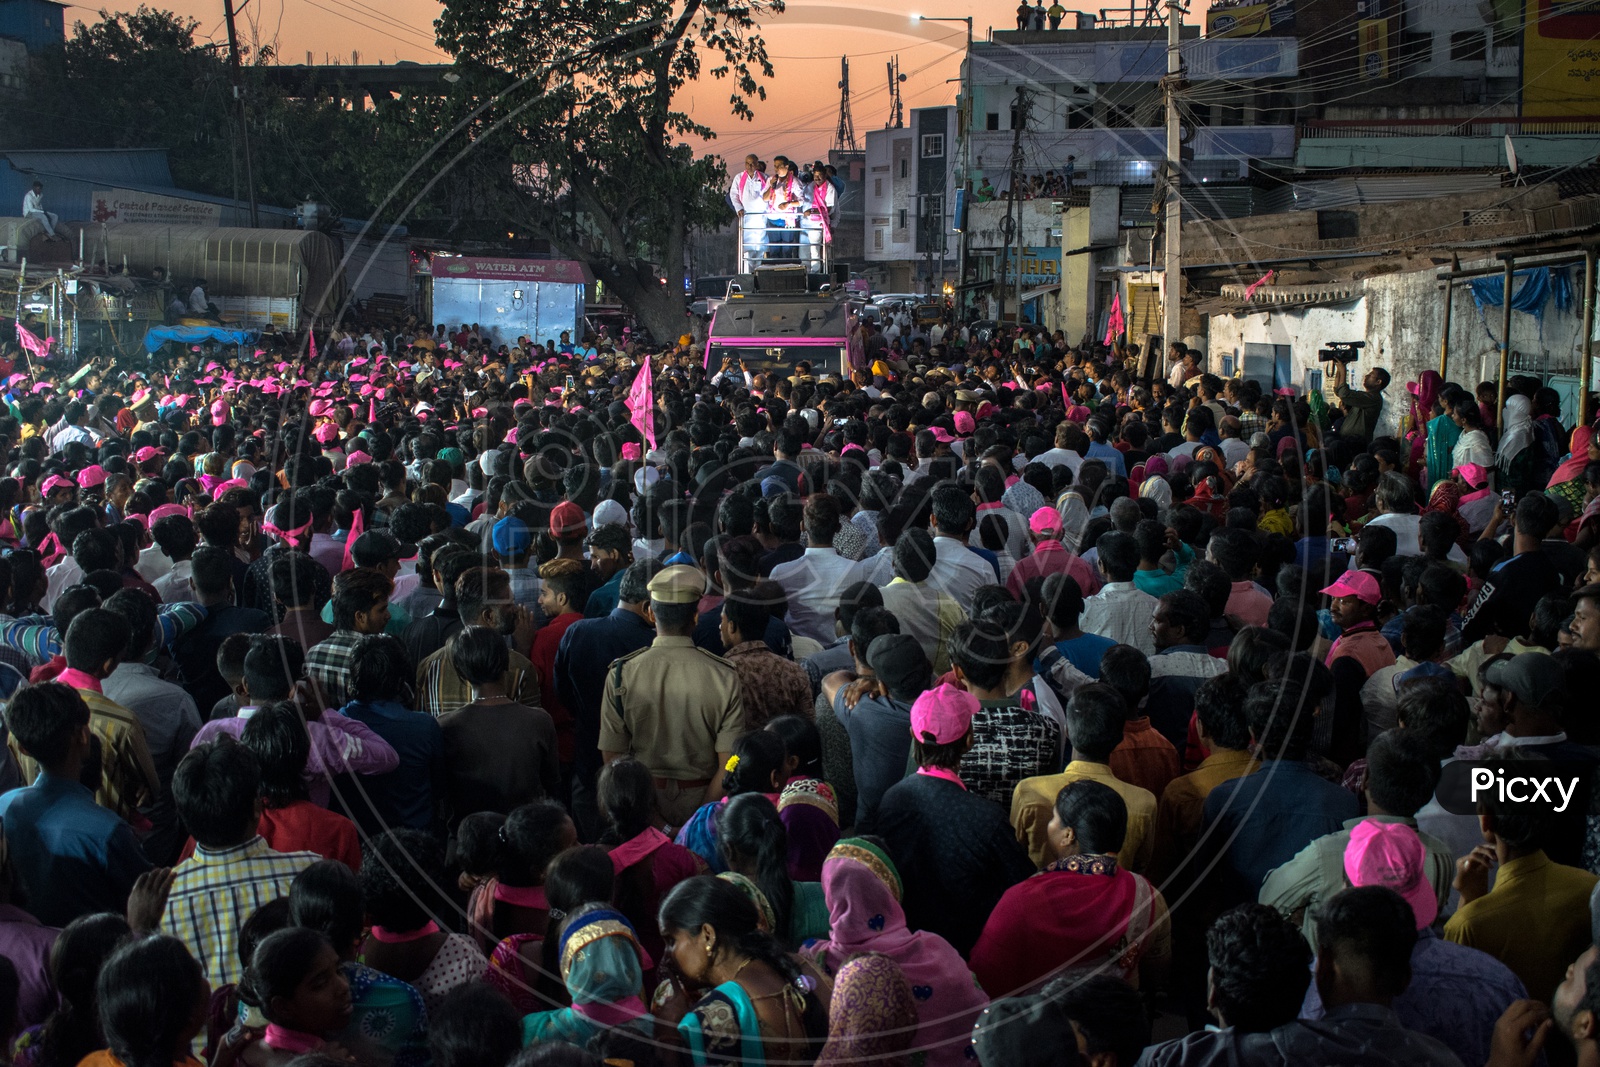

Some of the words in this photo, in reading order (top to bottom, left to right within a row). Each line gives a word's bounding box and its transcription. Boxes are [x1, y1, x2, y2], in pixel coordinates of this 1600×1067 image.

[113, 199, 149, 211] Central
[151, 202, 182, 213] Parcel
[183, 204, 213, 214] Service
[475, 263, 516, 272] WATER
[520, 265, 545, 273] ATM
